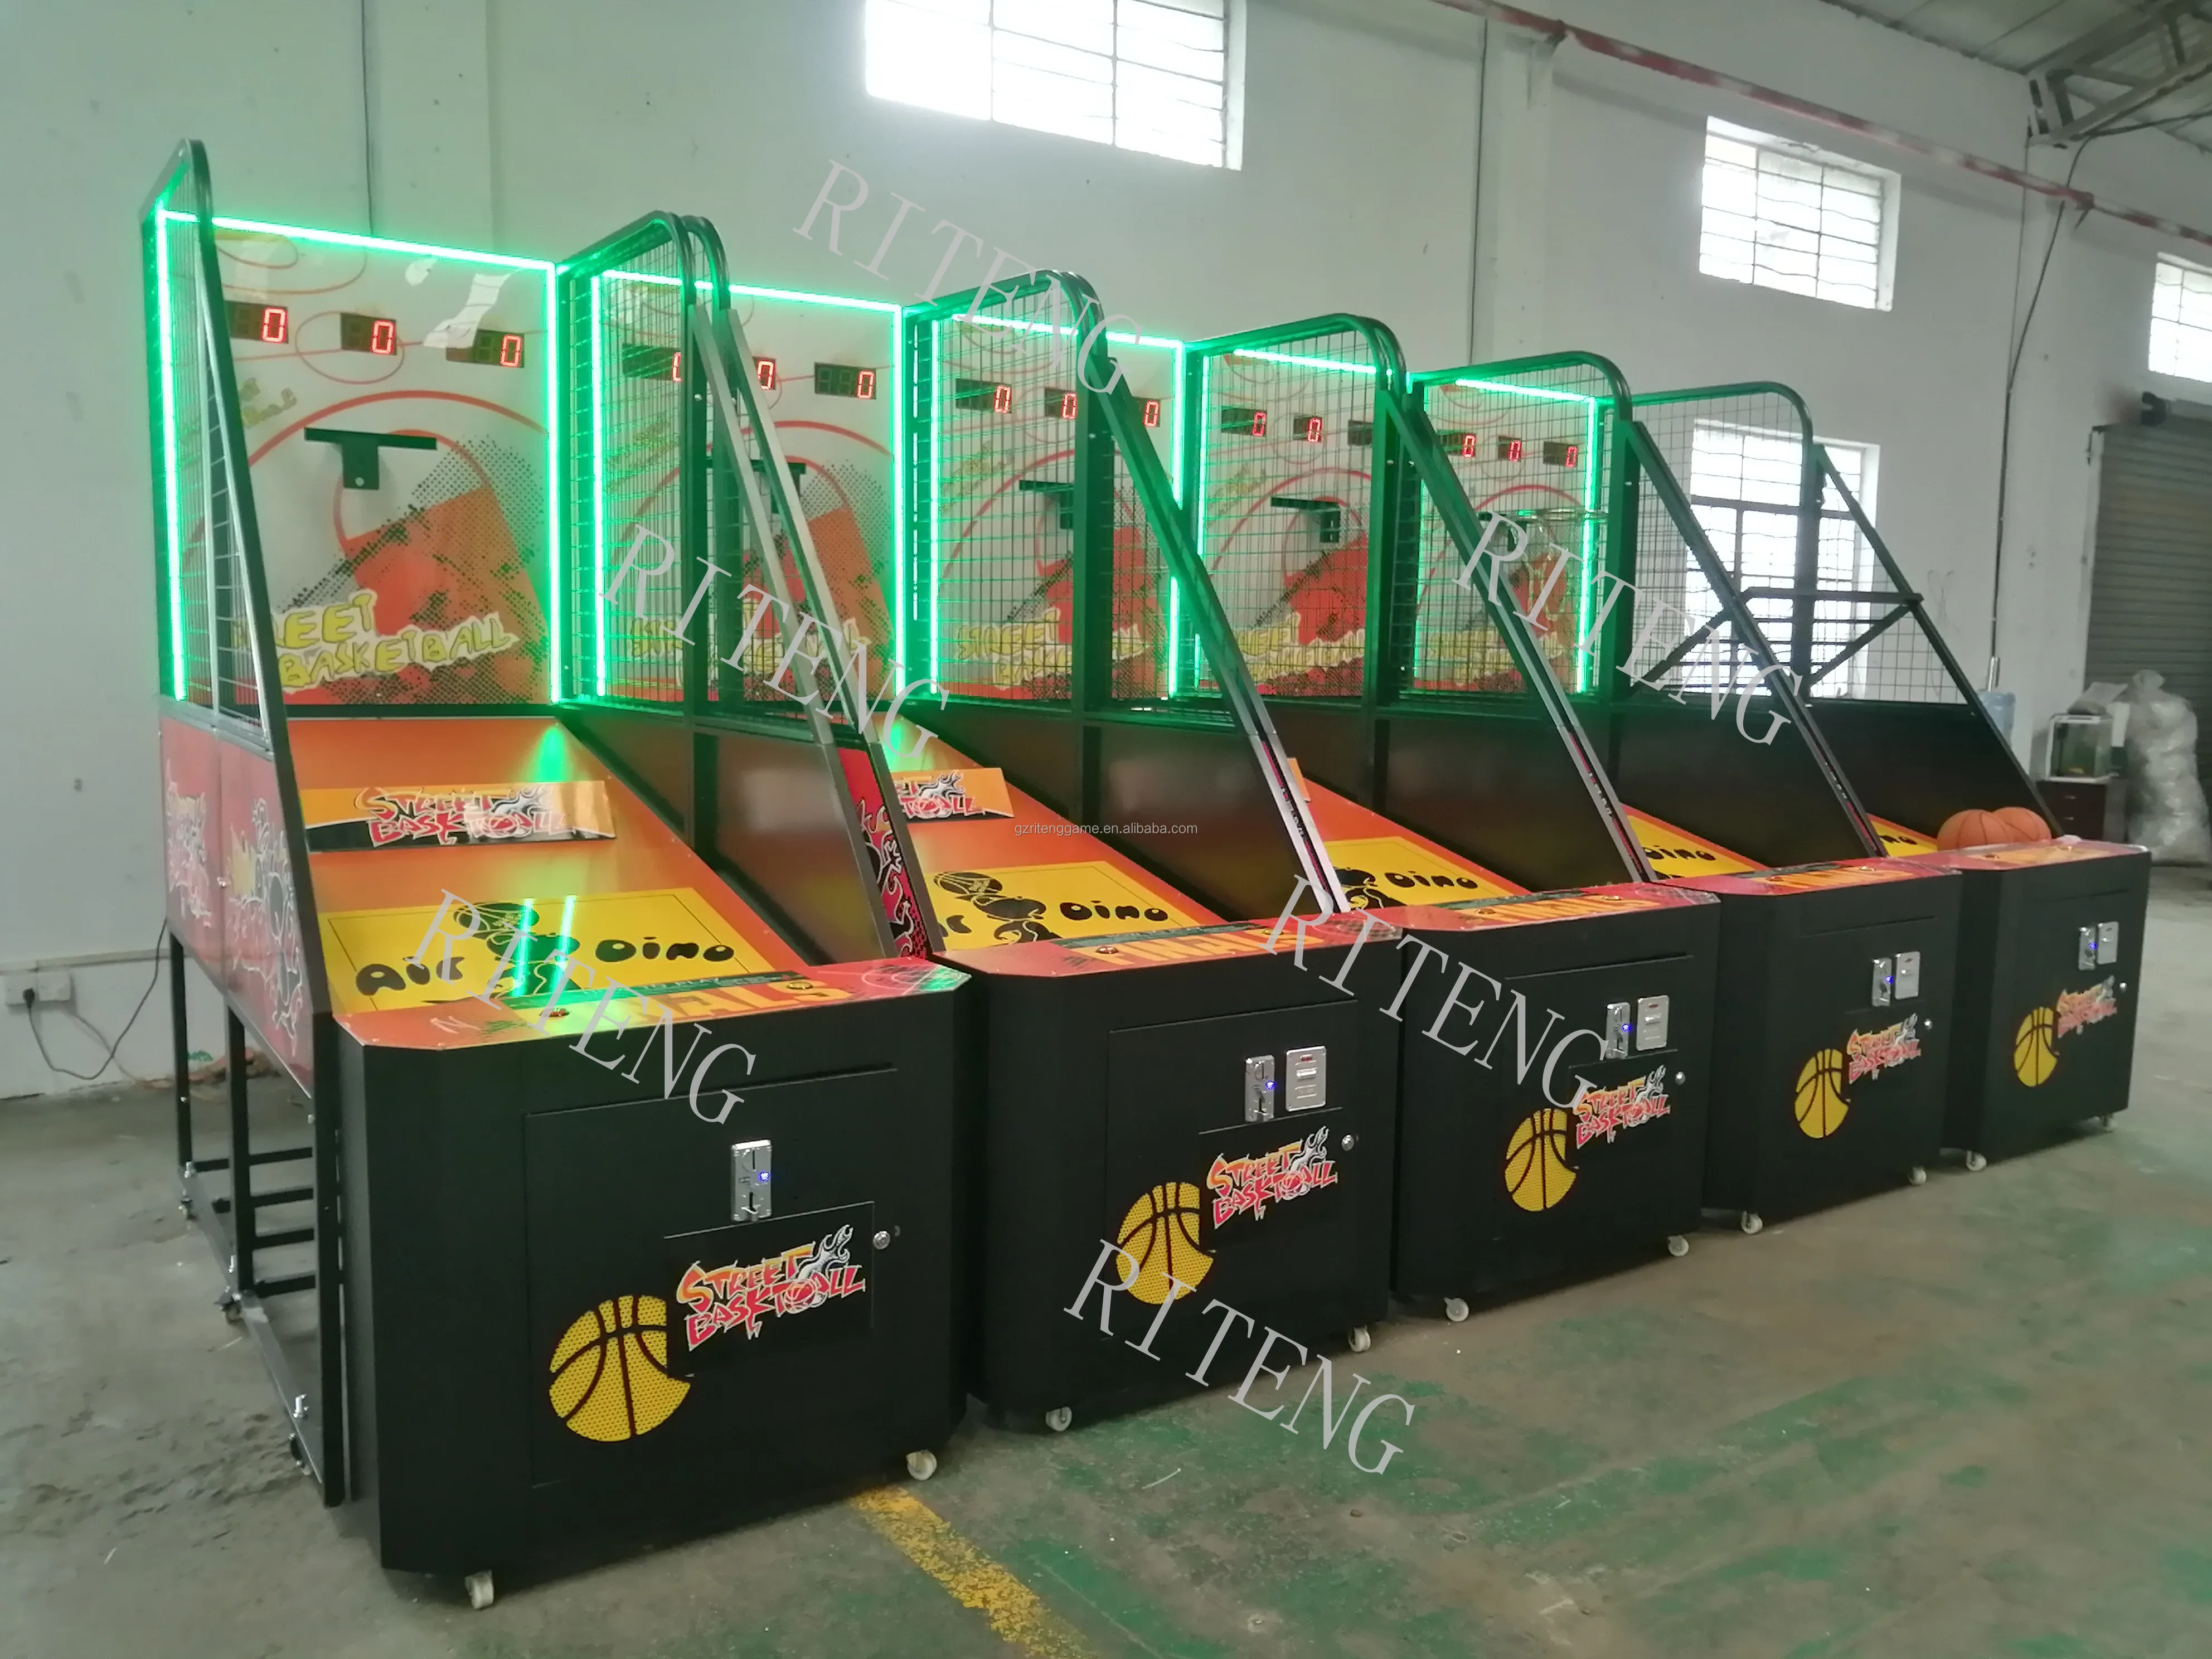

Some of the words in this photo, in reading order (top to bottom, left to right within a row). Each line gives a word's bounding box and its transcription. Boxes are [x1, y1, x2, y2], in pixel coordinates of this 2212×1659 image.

[262, 307, 288, 343] 0
[371, 319, 396, 355] 0
[499, 334, 523, 368] 0
[856, 370, 875, 400] 0
[993, 385, 1012, 414] 0
[1061, 392, 1078, 420] 0
[1142, 400, 1160, 428] 0
[1251, 410, 1267, 437] 0
[1306, 416, 1322, 443] 0
[1565, 446, 1578, 468] 0
[279, 613, 511, 688] BASKETBALL
[355, 787, 514, 821] STREET
[1573, 1075, 1646, 1123] STREET
[1207, 1138, 1303, 1197] STREET
[677, 1241, 816, 1313] STREET
